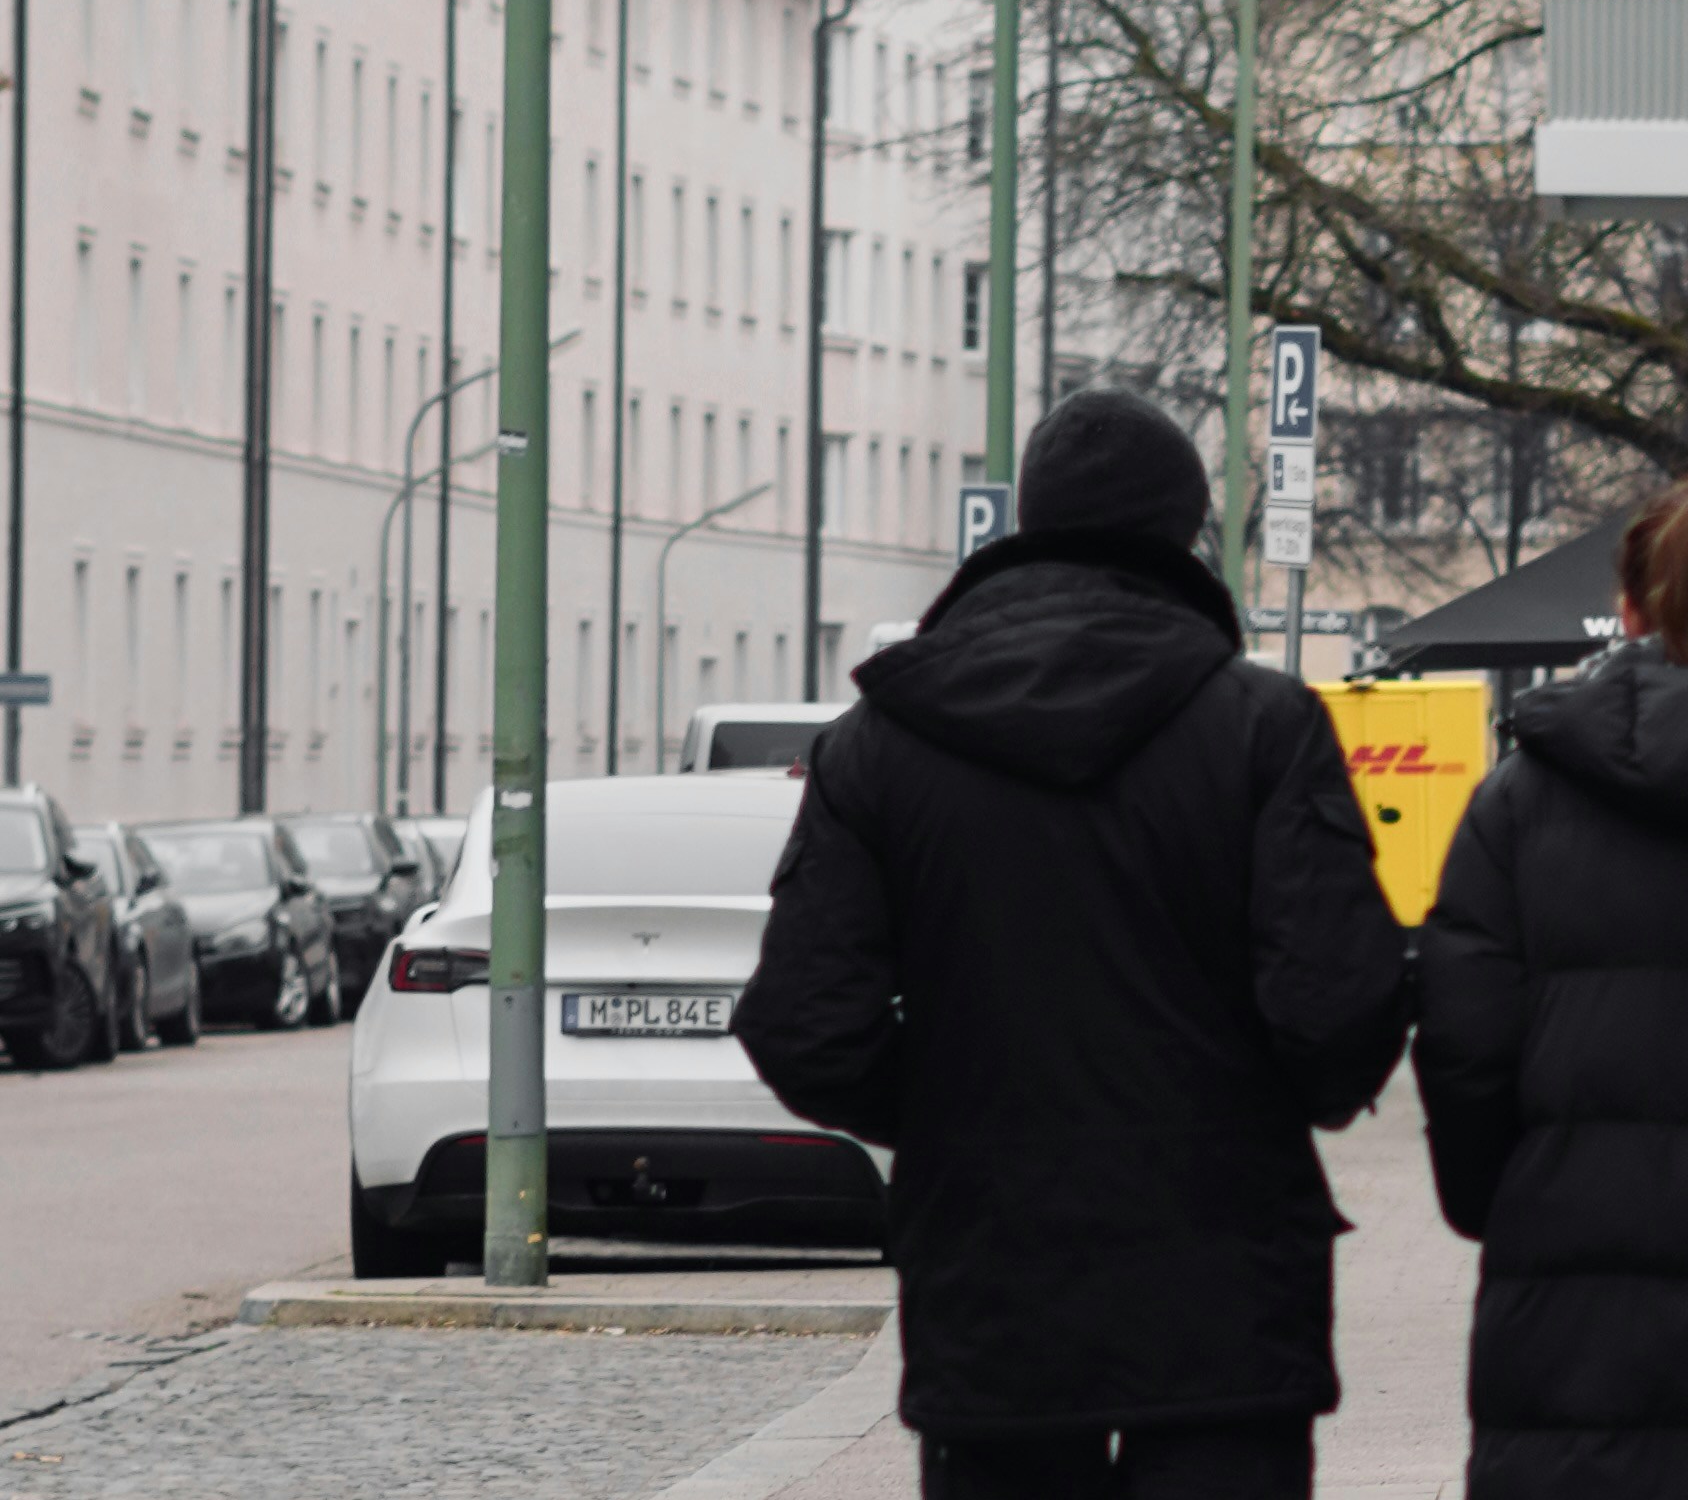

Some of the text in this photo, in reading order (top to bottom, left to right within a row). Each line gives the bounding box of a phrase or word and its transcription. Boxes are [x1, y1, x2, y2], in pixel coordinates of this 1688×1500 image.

[1276, 341, 1304, 427] P
[963, 495, 995, 556] P
[1346, 746, 1437, 775] HL
[591, 1000, 607, 1024] M
[627, 1000, 660, 1025] PL
